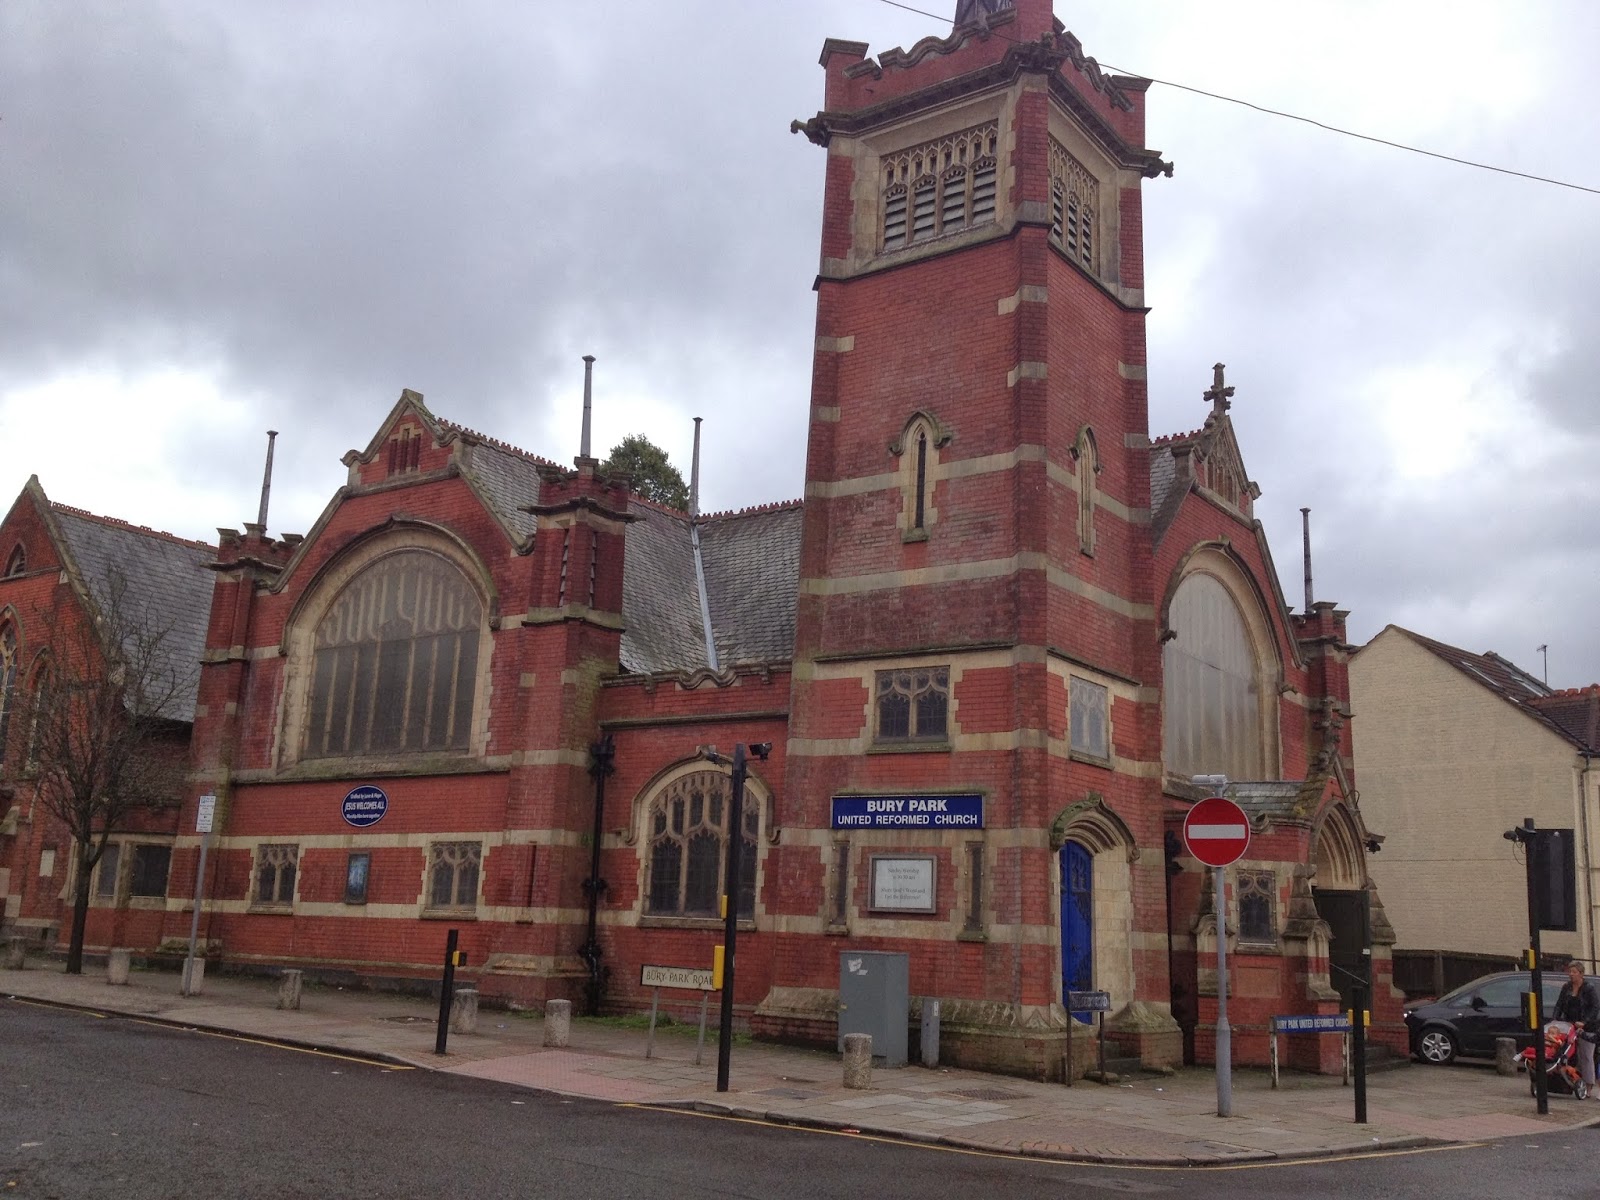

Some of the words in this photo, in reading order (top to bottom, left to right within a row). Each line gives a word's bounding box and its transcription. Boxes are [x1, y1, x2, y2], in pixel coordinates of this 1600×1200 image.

[344, 802, 356, 812] JESUS
[356, 801, 377, 810] WELCOMES
[867, 800, 906, 812] BURY
[909, 800, 948, 812] PARK
[838, 816, 871, 824] UNITED
[876, 815, 930, 824] REFORMED
[935, 814, 977, 824] CHURCH
[646, 969, 666, 983] BURY
[669, 972, 690, 984] PARK
[1276, 1020, 1288, 1029] BURY
[1288, 1020, 1299, 1029] PARK
[1299, 1019, 1314, 1028] UNITED
[1314, 1018, 1334, 1028] REFORMED
[1335, 1018, 1349, 1027] CHURC
